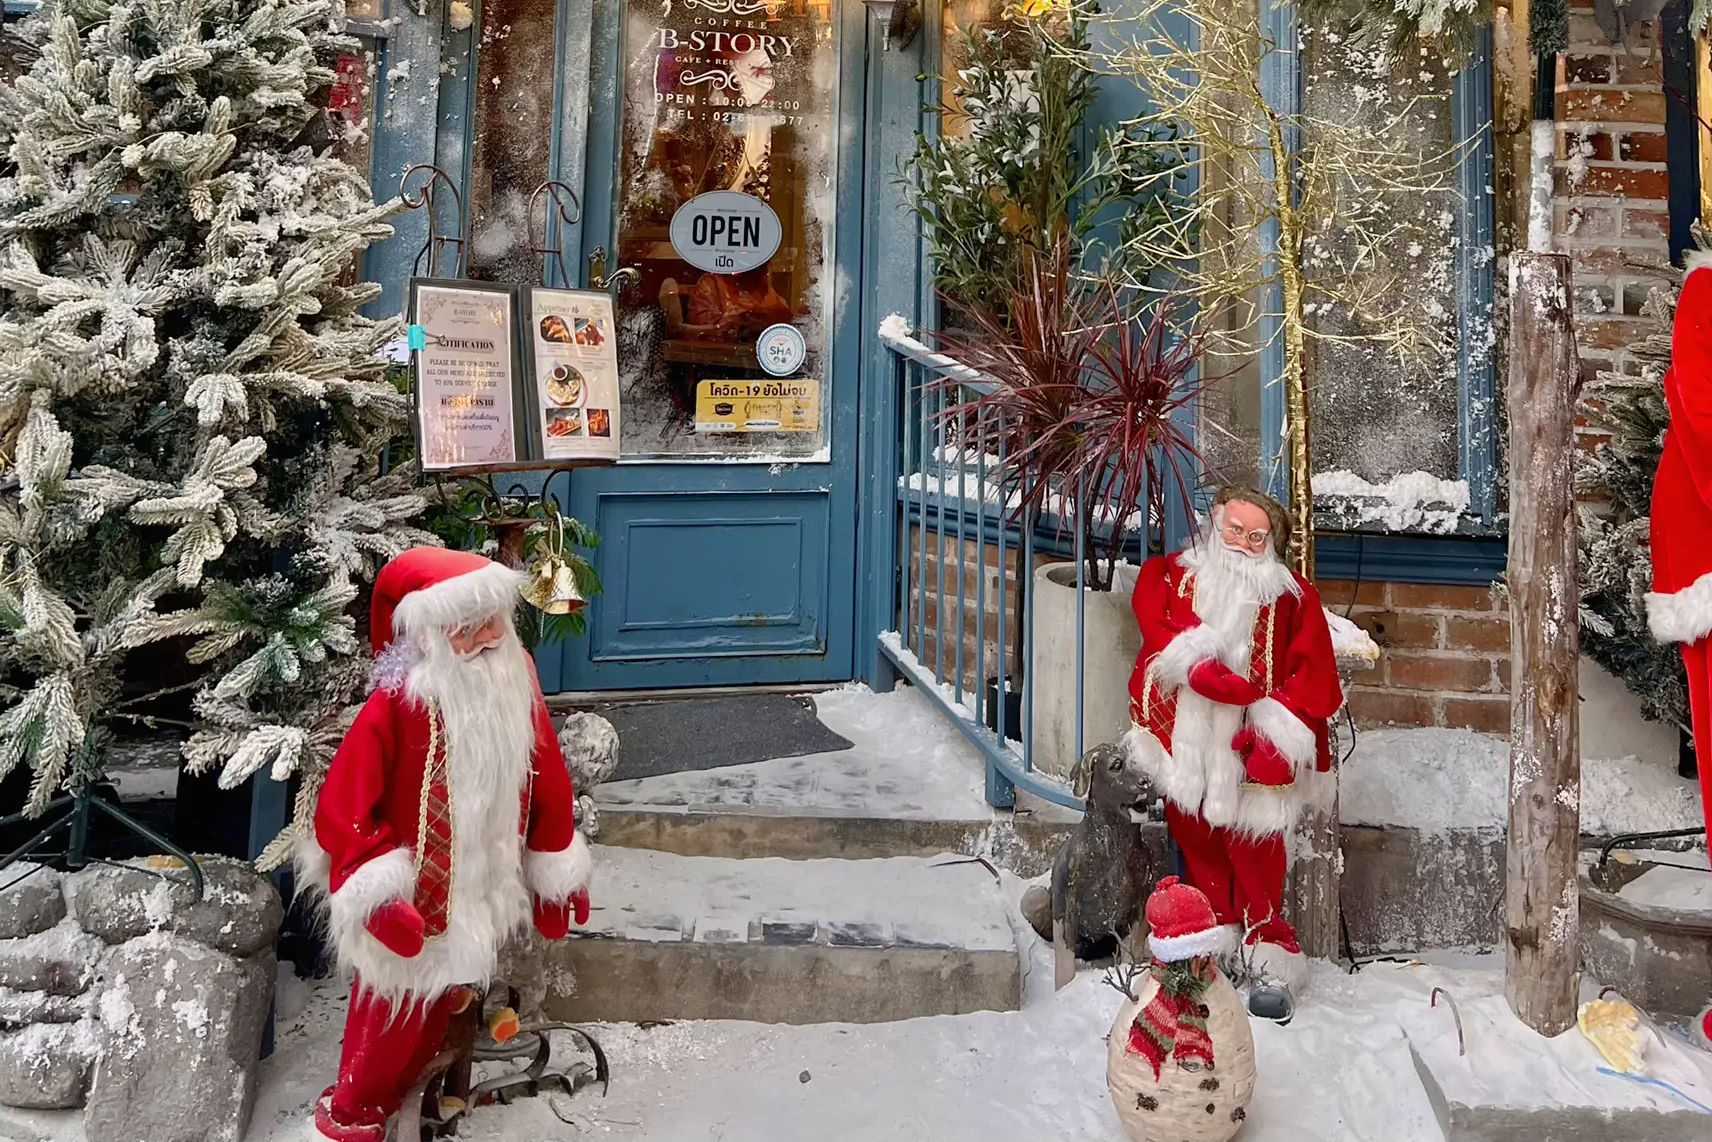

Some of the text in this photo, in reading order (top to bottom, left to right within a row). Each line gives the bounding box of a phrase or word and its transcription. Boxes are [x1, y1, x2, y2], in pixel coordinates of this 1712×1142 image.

[694, 16, 769, 31] COFFEE
[658, 27, 800, 58] B-STORY
[654, 92, 696, 105] OPEN
[667, 109, 695, 120] TEL
[692, 214, 761, 247] OPEN
[715, 254, 734, 268] เปิด
[438, 338, 494, 350] OTIFICATION
[769, 345, 792, 357] SHA
